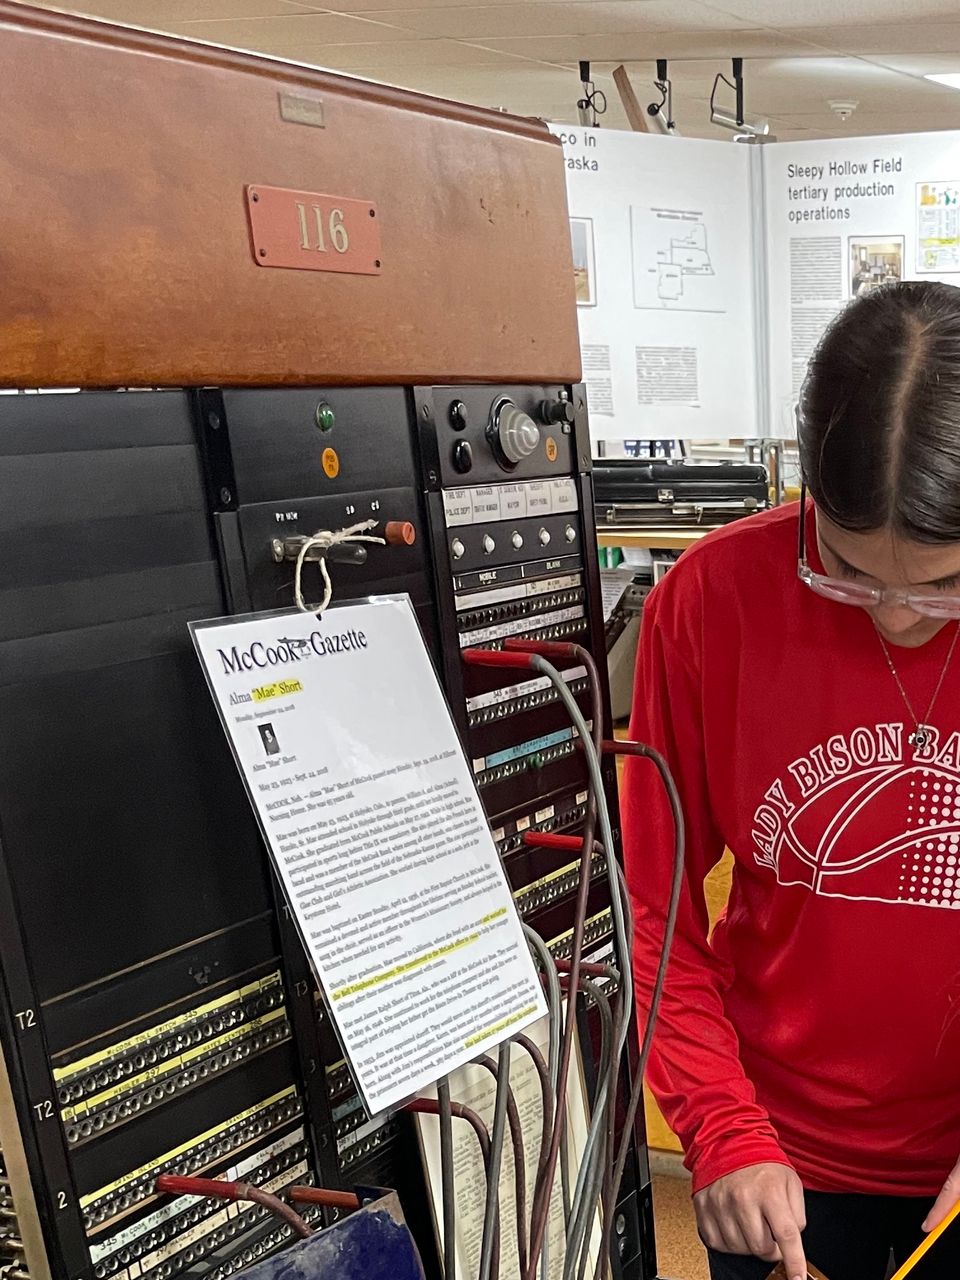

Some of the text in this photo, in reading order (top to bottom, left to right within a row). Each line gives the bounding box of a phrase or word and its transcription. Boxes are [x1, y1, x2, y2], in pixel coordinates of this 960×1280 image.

[584, 131, 597, 148] in
[787, 157, 903, 180] Sleepy Hollow Field
[788, 182, 895, 201] tertiary production
[788, 206, 850, 224] operations
[296, 201, 349, 255] 116
[217, 628, 367, 674] McCook Gazette
[230, 691, 252, 705] Alma
[278, 680, 303, 694] Short
[752, 778, 794, 874] LADY
[788, 722, 903, 798] BISON
[294, 980, 309, 998] T3
[15, 1009, 37, 1031] T2
[134, 1030, 152, 1044] TOLL
[153, 1019, 178, 1035] SWITCH
[145, 1066, 161, 1081] 297
[33, 1100, 54, 1122] T2
[113, 1172, 136, 1188] GRAND
[57, 1191, 68, 1210] 2
